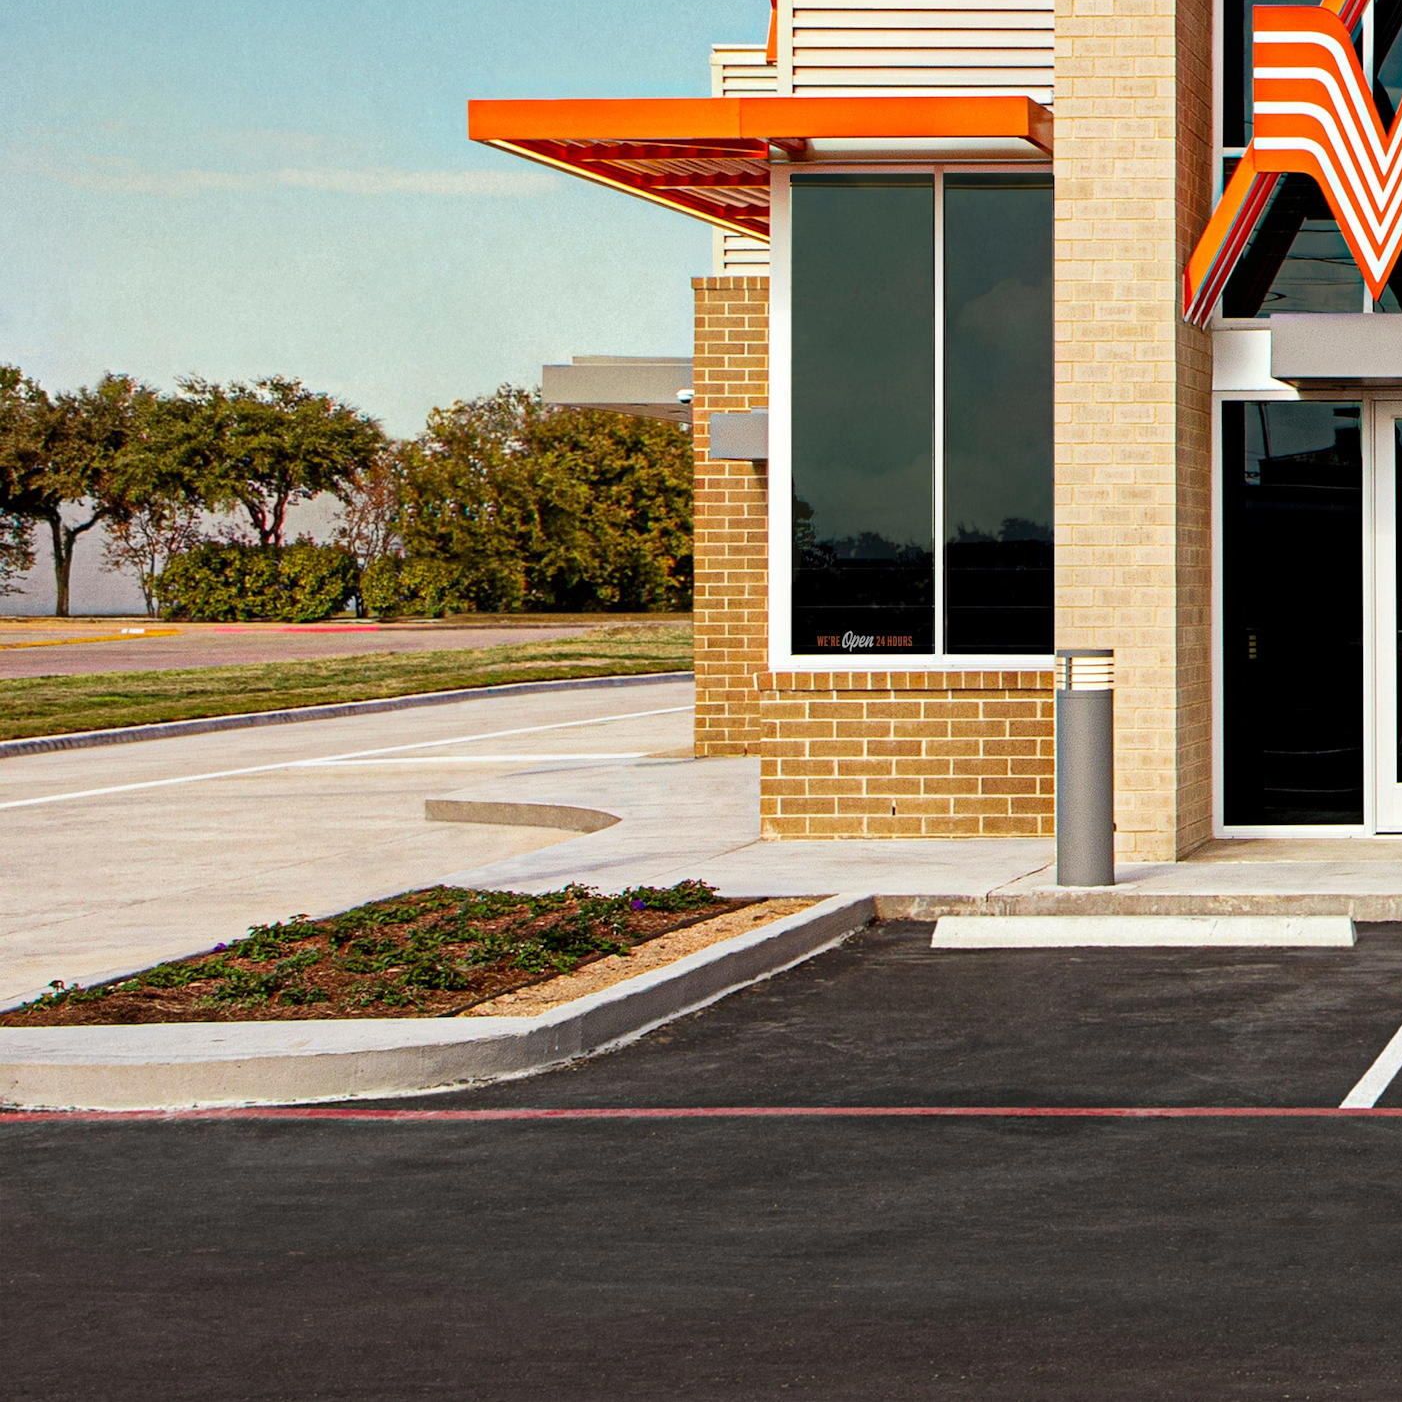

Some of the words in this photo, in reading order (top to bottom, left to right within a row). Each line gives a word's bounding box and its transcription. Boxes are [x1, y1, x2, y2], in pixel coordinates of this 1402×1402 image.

[816, 635, 840, 646] WE'RE
[841, 630, 874, 652] Open
[876, 635, 885, 646] 24
[887, 636, 912, 646] HOURS
